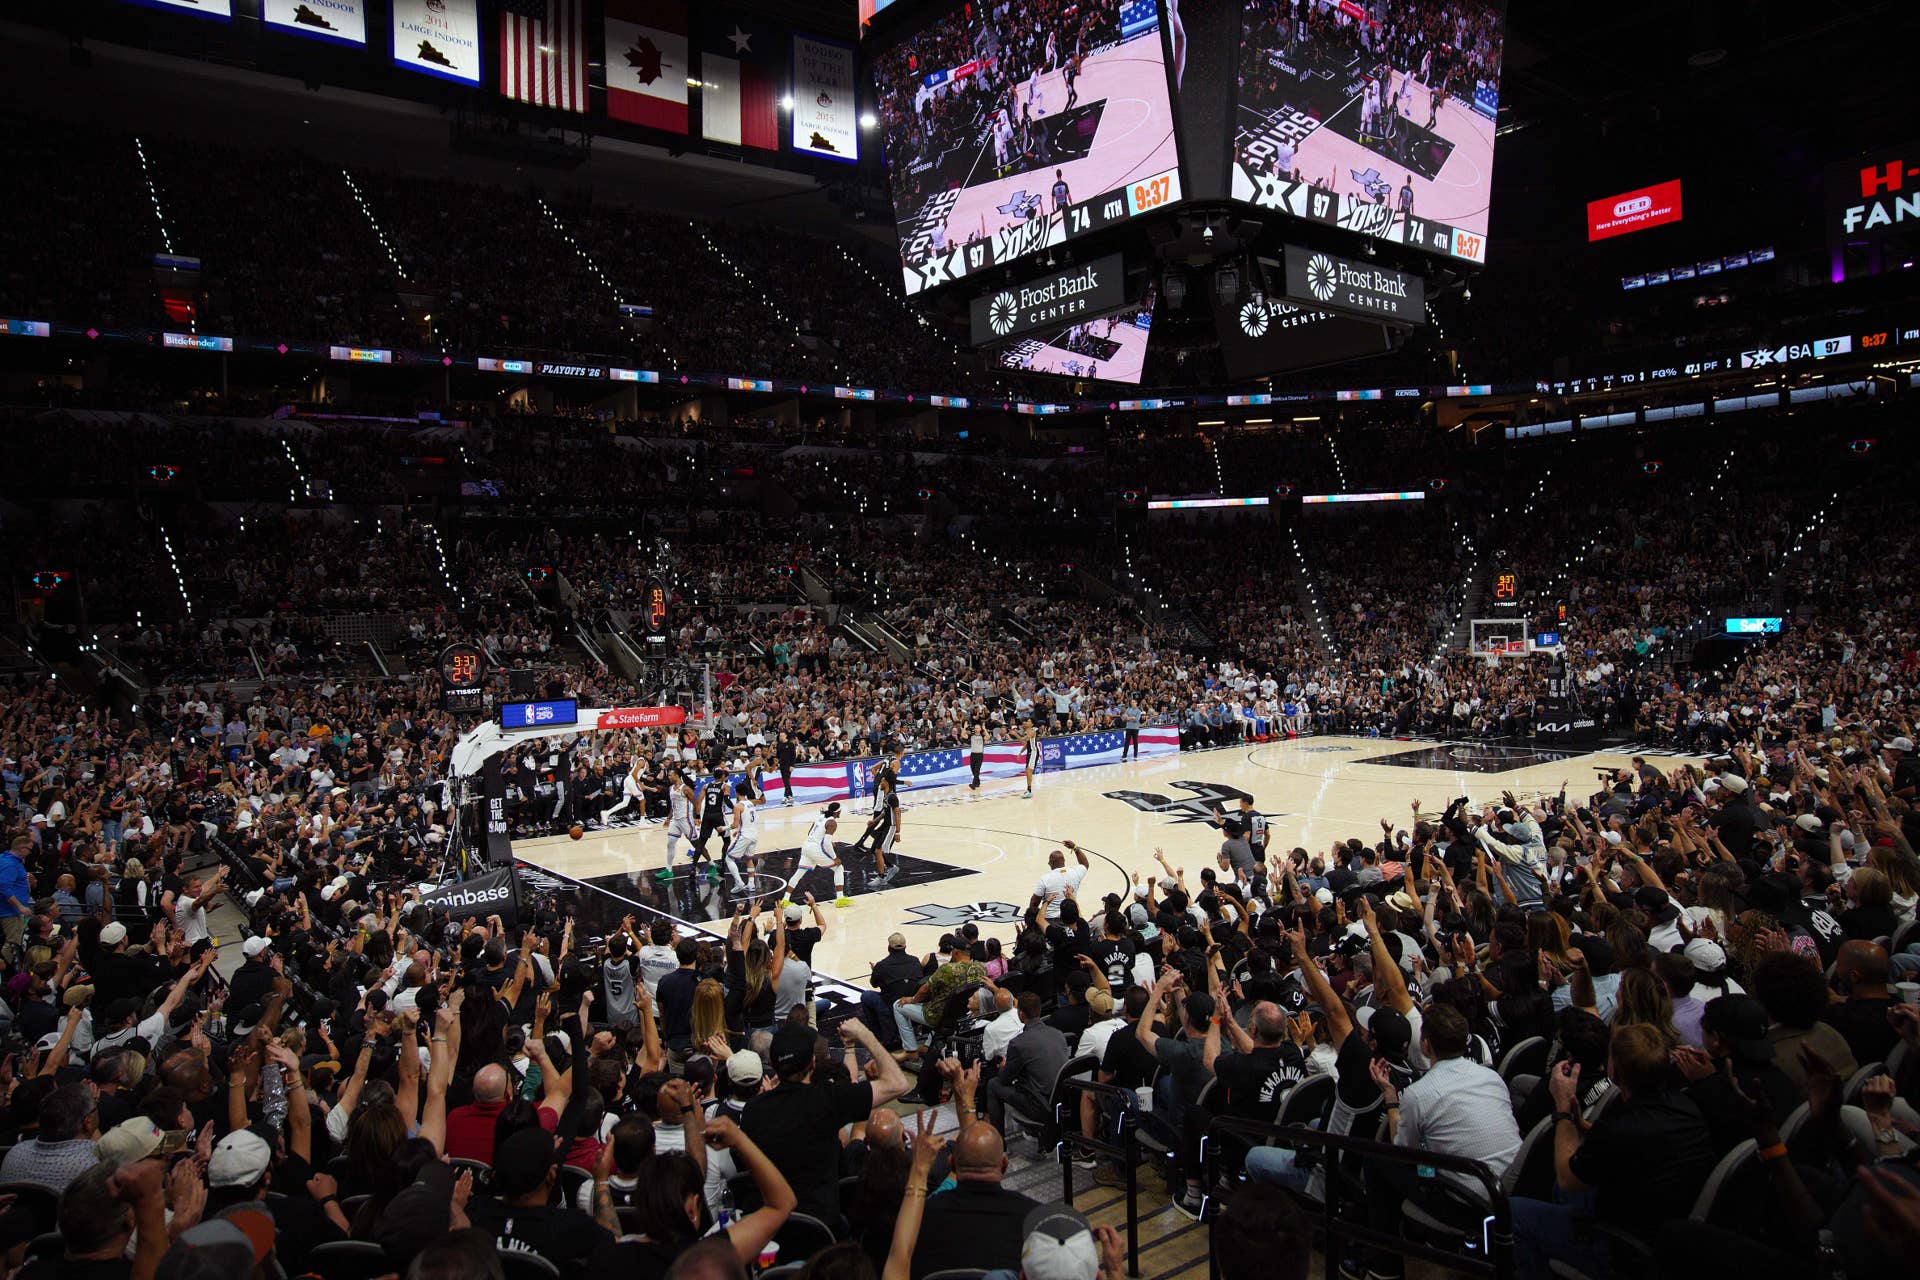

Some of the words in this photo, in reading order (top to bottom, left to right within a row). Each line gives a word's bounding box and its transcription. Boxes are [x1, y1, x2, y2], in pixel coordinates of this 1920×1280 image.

[426, 14, 448, 29] 2014
[401, 21, 433, 36] LARGE
[434, 32, 473, 49] INDOOR
[1268, 57, 1297, 76] coinbase
[816, 111, 834, 123] 2015
[800, 121, 820, 131] LARGE
[823, 125, 849, 136] INDOOR
[910, 161, 933, 175] coinbase
[1135, 176, 1170, 211] 9:37
[1103, 199, 1122, 220] 4TH
[1314, 193, 1330, 218] 97
[1071, 206, 1090, 233] 74
[1596, 222, 1611, 231] Here
[1612, 211, 1649, 226] Everything's
[1650, 207, 1672, 218] Better
[1410, 220, 1424, 244] 74
[1433, 232, 1448, 250] 4TH
[1457, 233, 1480, 259] 9:37
[970, 244, 984, 268] 97
[1019, 283, 1055, 310] Frost
[1058, 266, 1099, 298] Bank
[1338, 262, 1373, 290] Frost
[1374, 271, 1408, 299] Bank
[1348, 292, 1397, 313] CENTER
[1030, 299, 1087, 323] CENTER
[166, 335, 216, 348] Bitdefender
[1861, 333, 1888, 348] 9:37
[1903, 329, 1920, 341] 4TH
[1790, 345, 1812, 360] SA
[1825, 341, 1839, 353] 97
[542, 363, 586, 378] PLAYOFFS
[587, 367, 602, 378] '26
[1652, 367, 1677, 380] FG%
[1684, 363, 1701, 375] 47.1
[1703, 361, 1718, 371] PF
[1726, 358, 1732, 369] 2
[1620, 374, 1635, 383] TO
[1499, 575, 1515, 584] 9:37
[1497, 583, 1514, 598] 24
[454, 655, 476, 667] 9:37
[452, 667, 473, 682] 24
[456, 688, 481, 696] TISSOT
[536, 711, 554, 720] 250
[1537, 722, 1570, 732] KIA
[1573, 719, 1595, 729] coinbase
[1043, 749, 1061, 761] 250
[490, 798, 503, 810] GET
[708, 793, 717, 806] 3
[490, 809, 504, 821] THE
[494, 820, 507, 834] App
[1103, 951, 1130, 965] HARPER
[611, 981, 622, 996] 5
[1259, 1066, 1305, 1103] WEMBANYA
